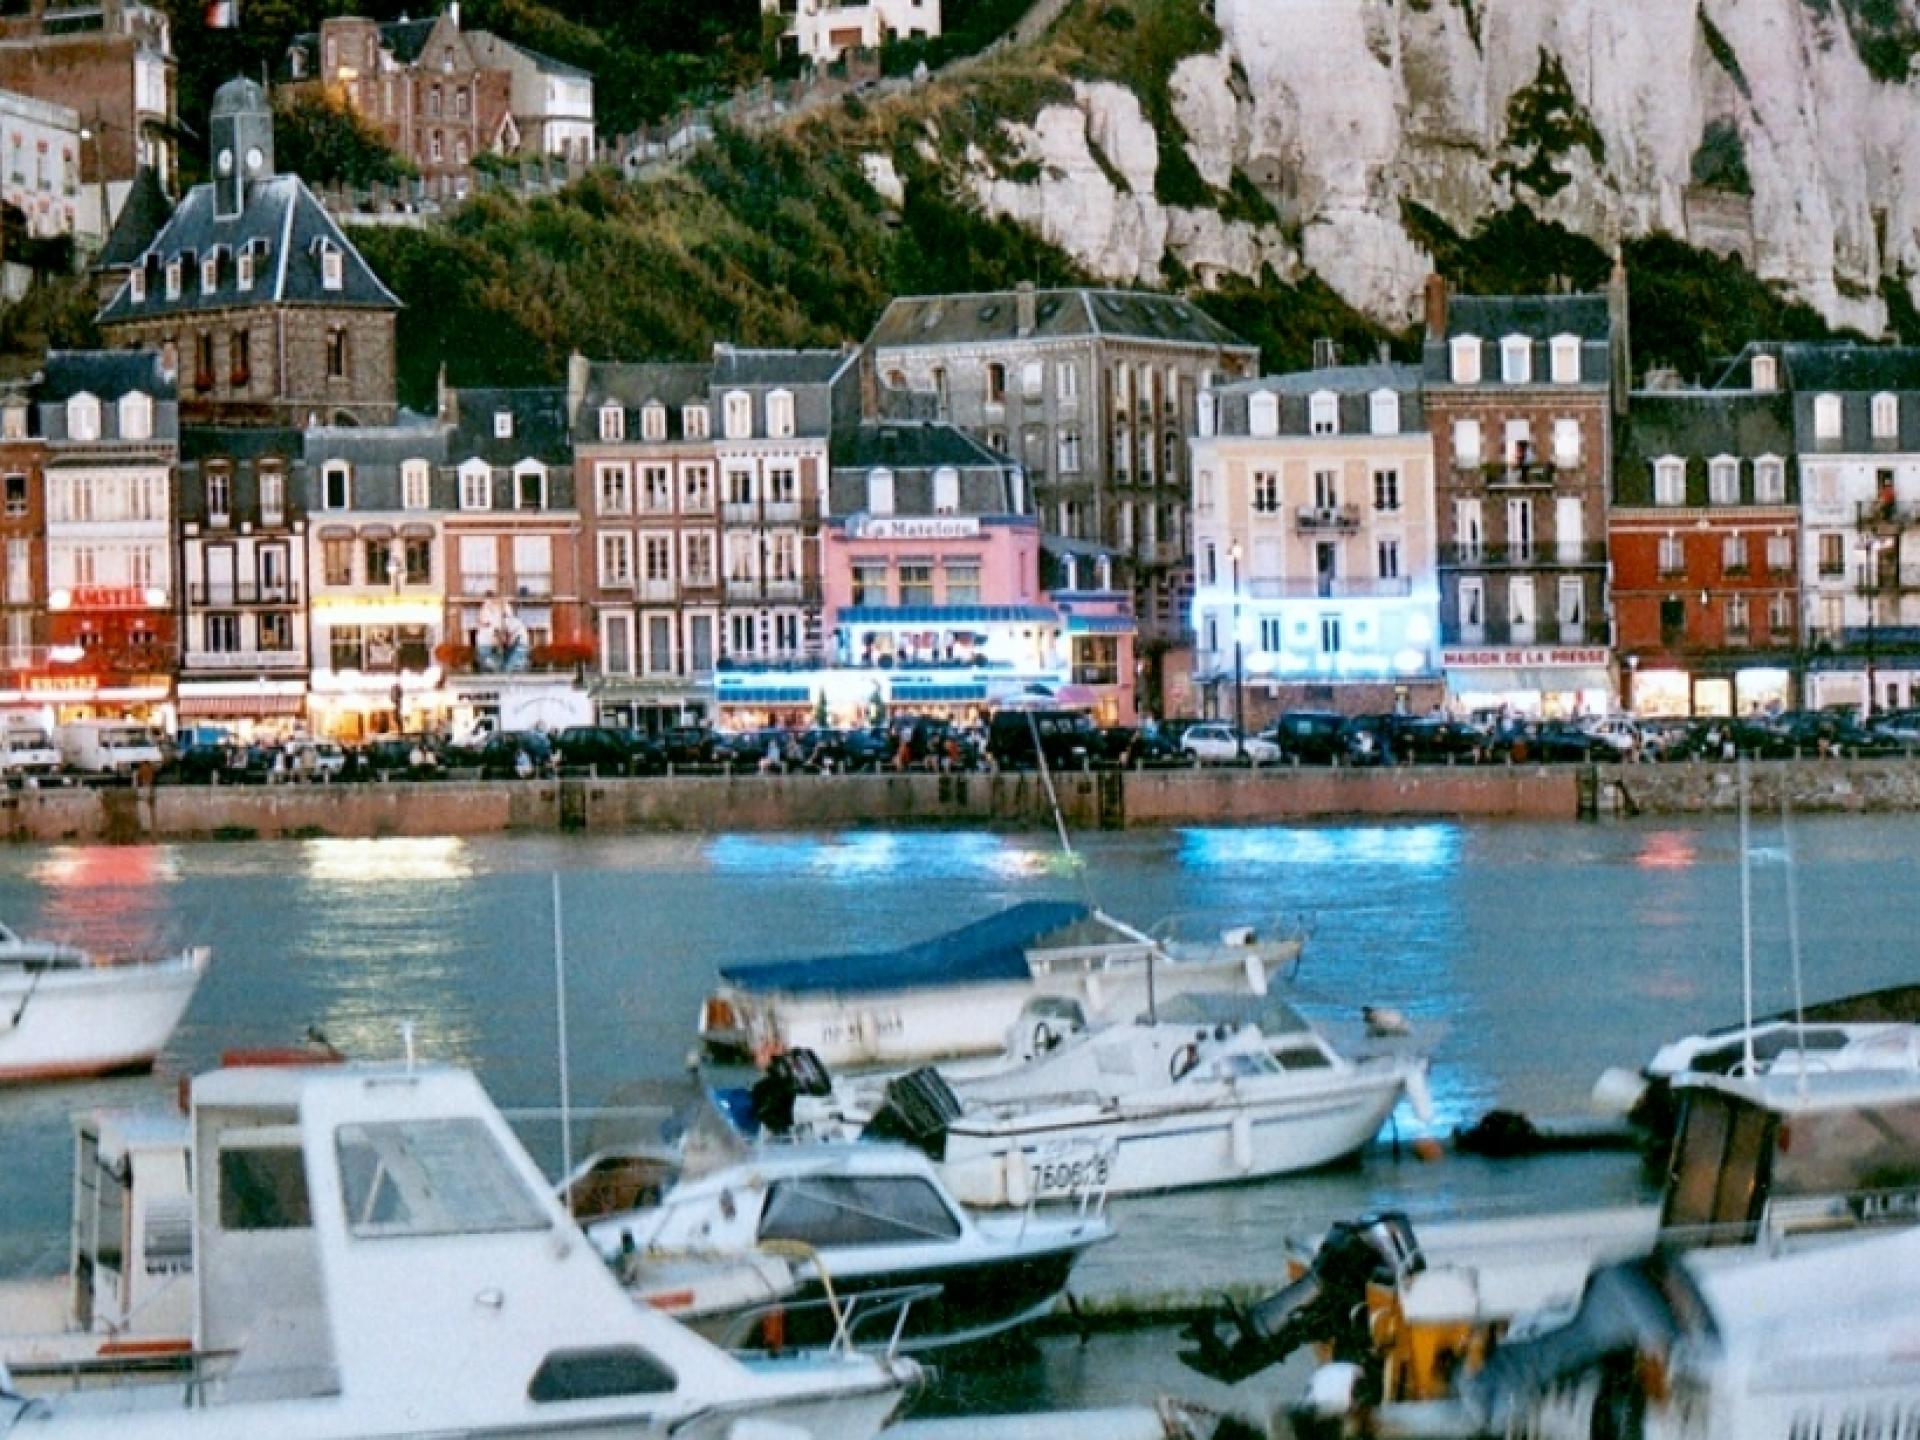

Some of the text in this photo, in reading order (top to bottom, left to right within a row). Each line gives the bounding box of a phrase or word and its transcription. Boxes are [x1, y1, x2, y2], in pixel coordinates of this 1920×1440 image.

[862, 520, 886, 537] La
[1444, 649, 1606, 665] MAISON DE LA PRESSE
